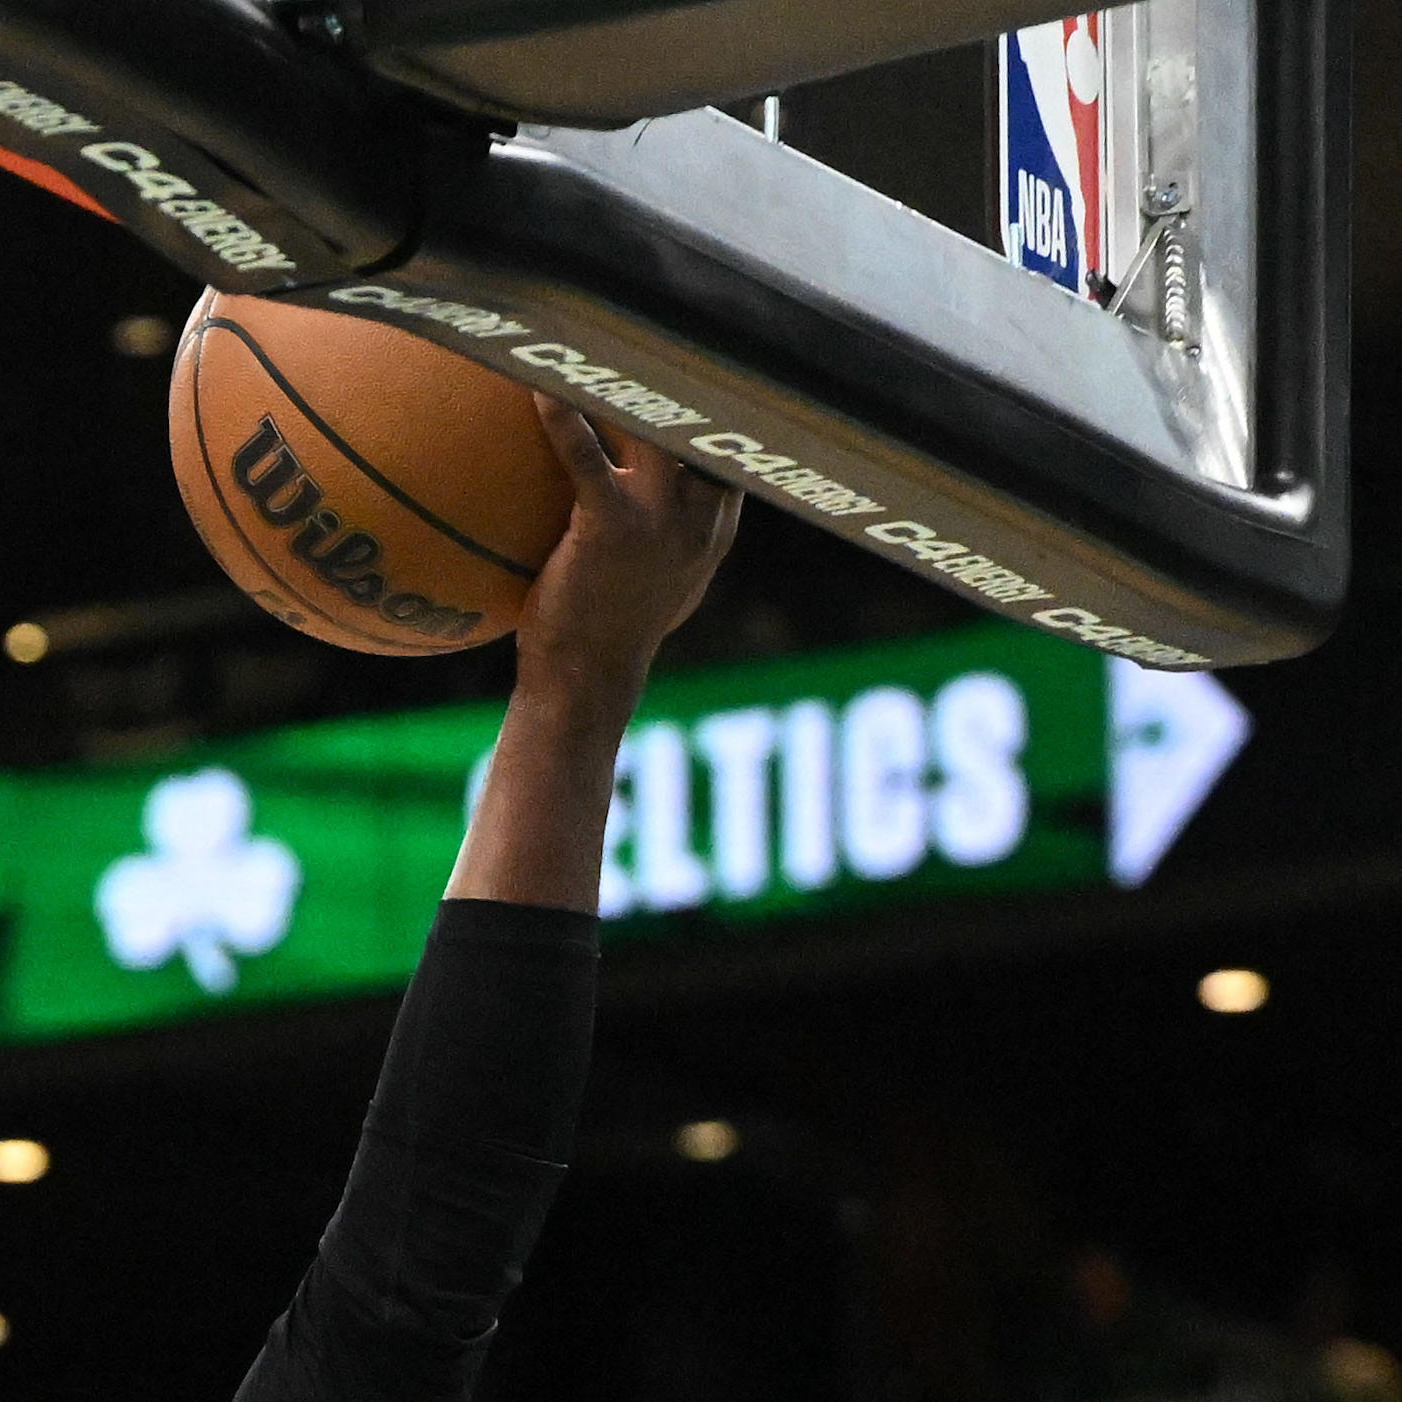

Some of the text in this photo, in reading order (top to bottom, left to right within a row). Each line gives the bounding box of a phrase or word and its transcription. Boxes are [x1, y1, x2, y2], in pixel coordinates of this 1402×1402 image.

[1017, 169, 1068, 269] NBA
[232, 412, 485, 640] Wilson
[465, 670, 1028, 920] ELTICS
